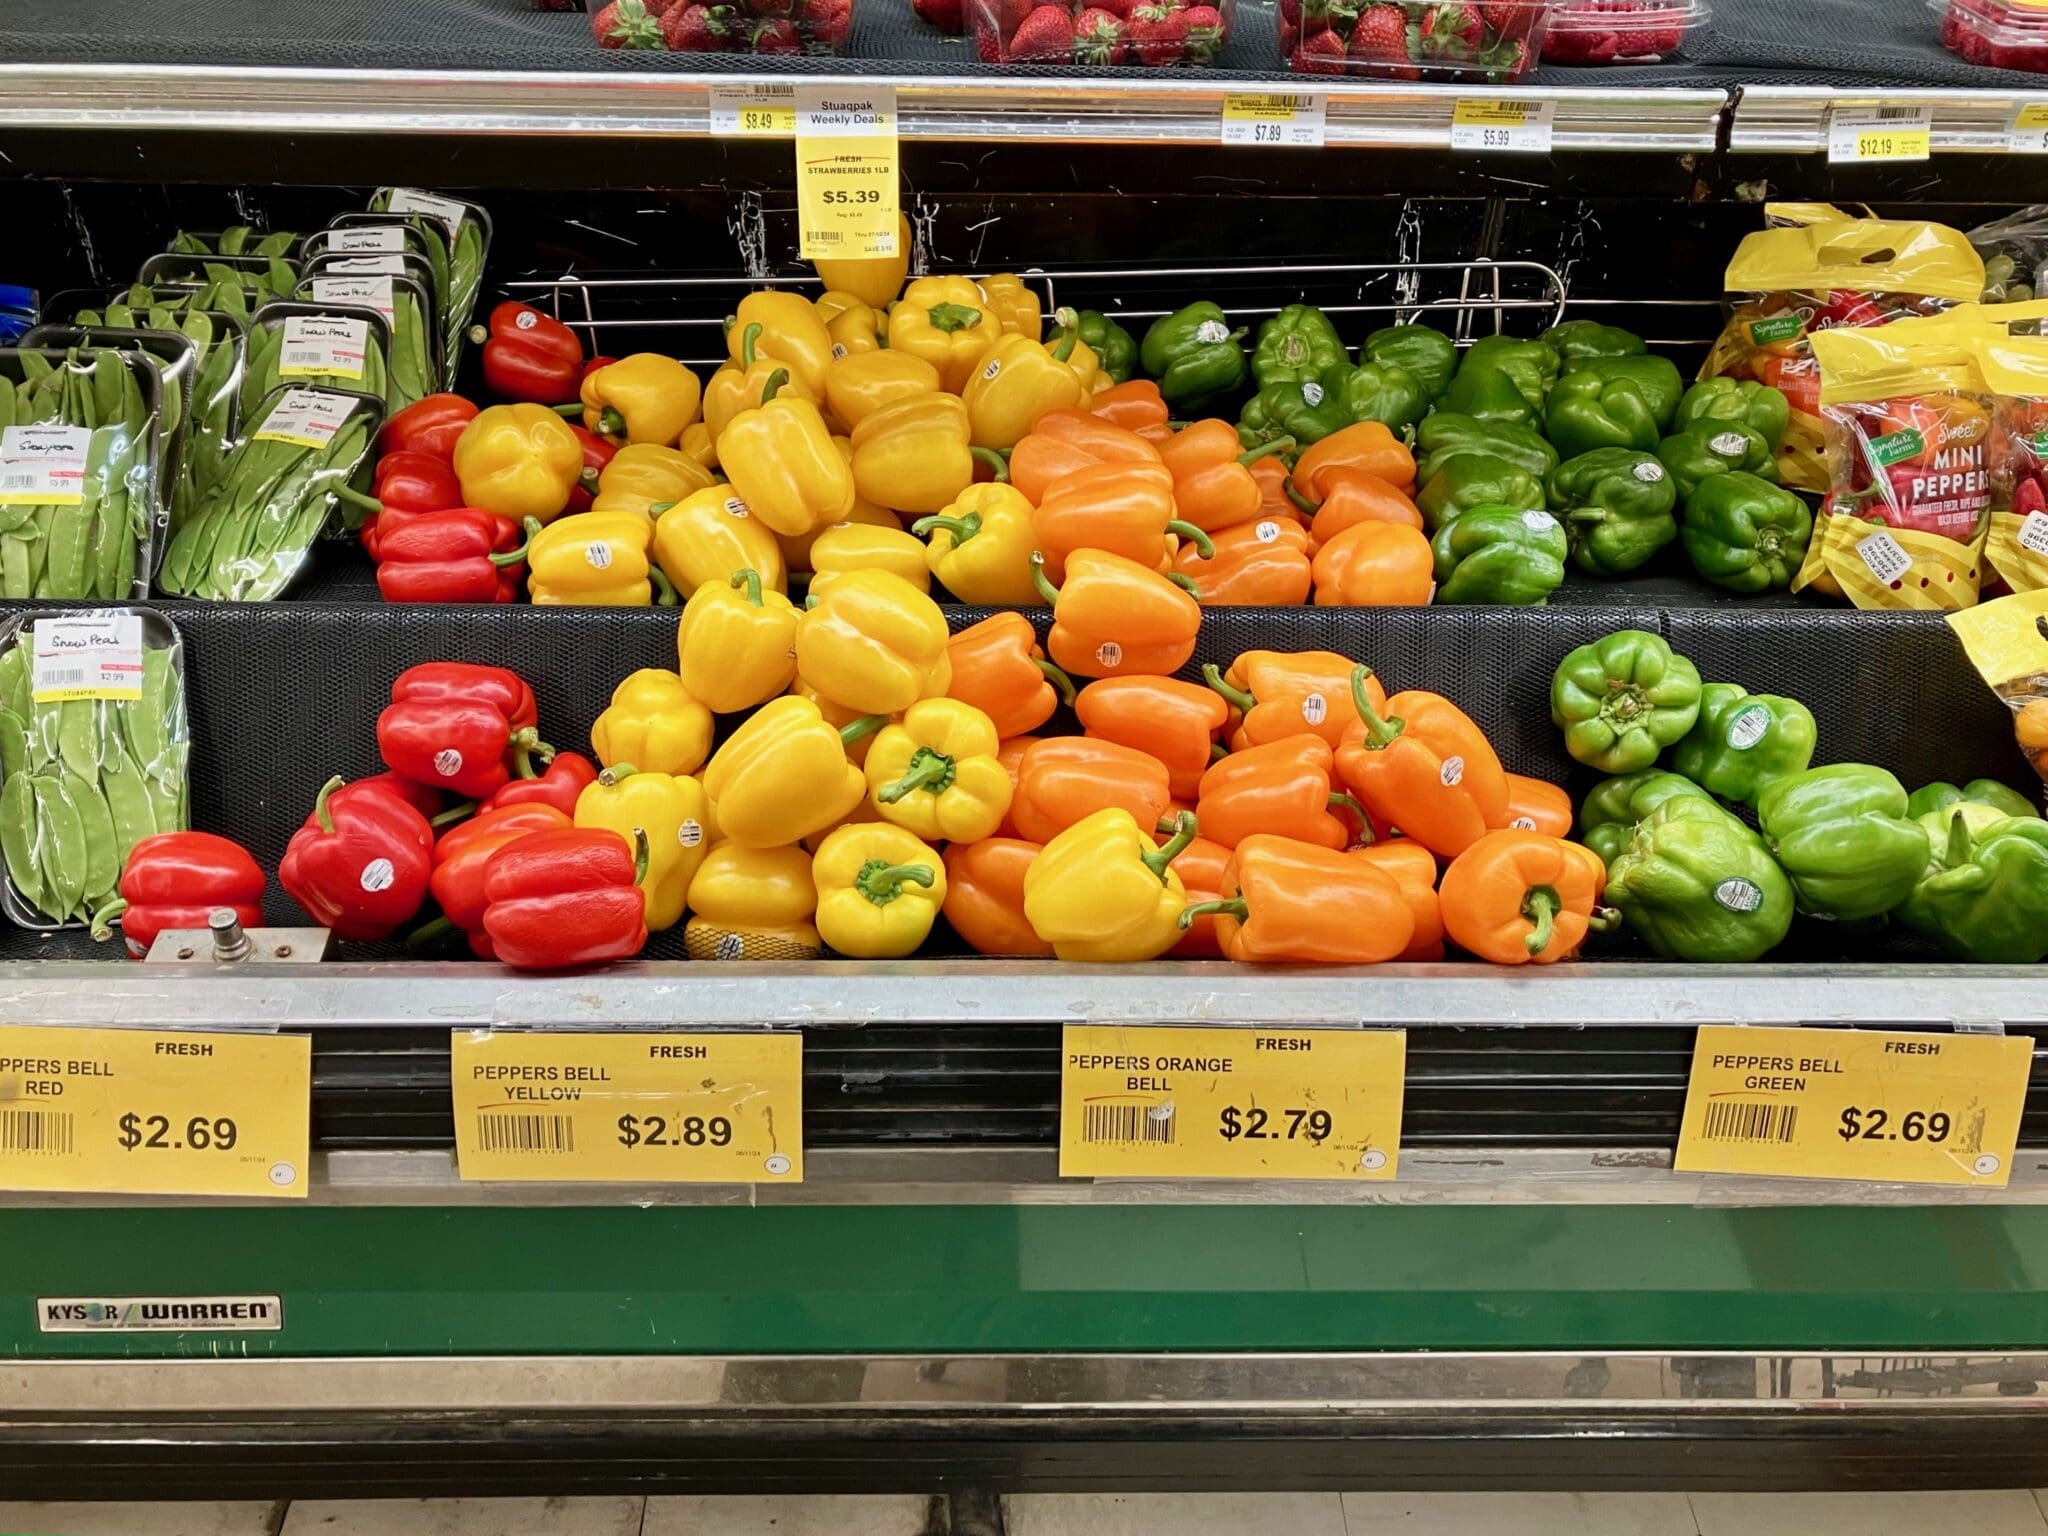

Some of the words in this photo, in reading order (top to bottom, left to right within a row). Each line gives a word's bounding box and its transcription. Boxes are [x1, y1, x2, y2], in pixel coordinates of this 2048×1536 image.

[821, 101, 873, 112] Stuaqpak
[745, 112, 772, 130] $8.49
[811, 114, 851, 126] Weekly
[853, 114, 884, 124] Deals
[1255, 124, 1281, 141] $7.89
[1483, 129, 1510, 146] $5.99
[1860, 138, 1892, 155] $12.19
[834, 155, 862, 163] FRESH
[823, 190, 880, 204] $5.39
[1938, 419, 1979, 444] Sweet
[1934, 445, 1982, 470] MINI
[1861, 549, 1887, 580] MEXICO
[51, 636, 87, 647] Snow
[155, 1042, 213, 1056] FRESH
[650, 1046, 707, 1058] FRESH
[1255, 1038, 1312, 1051] FRESH
[1884, 1041, 1941, 1055] FRESH
[0, 1058, 61, 1074] PPERS
[68, 1062, 114, 1076] BELL
[1070, 1054, 1150, 1071] PEPPERS
[1155, 1056, 1233, 1073] ORANGE
[1712, 1054, 1794, 1071] PEPPERS
[1799, 1058, 1844, 1074] BELL
[473, 1066, 559, 1081] PEPPERS
[564, 1067, 611, 1081] BELL
[25, 1081, 63, 1096] RED
[1126, 1077, 1173, 1092] BELL
[1745, 1076, 1806, 1092] GREEN
[504, 1086, 582, 1101] YELLOW
[118, 1112, 237, 1151] $2.69
[617, 1114, 732, 1149] $2.89
[1219, 1105, 1332, 1142] $2.79
[1838, 1106, 1951, 1144] $2.69
[141, 1303, 267, 1320] WARREN
